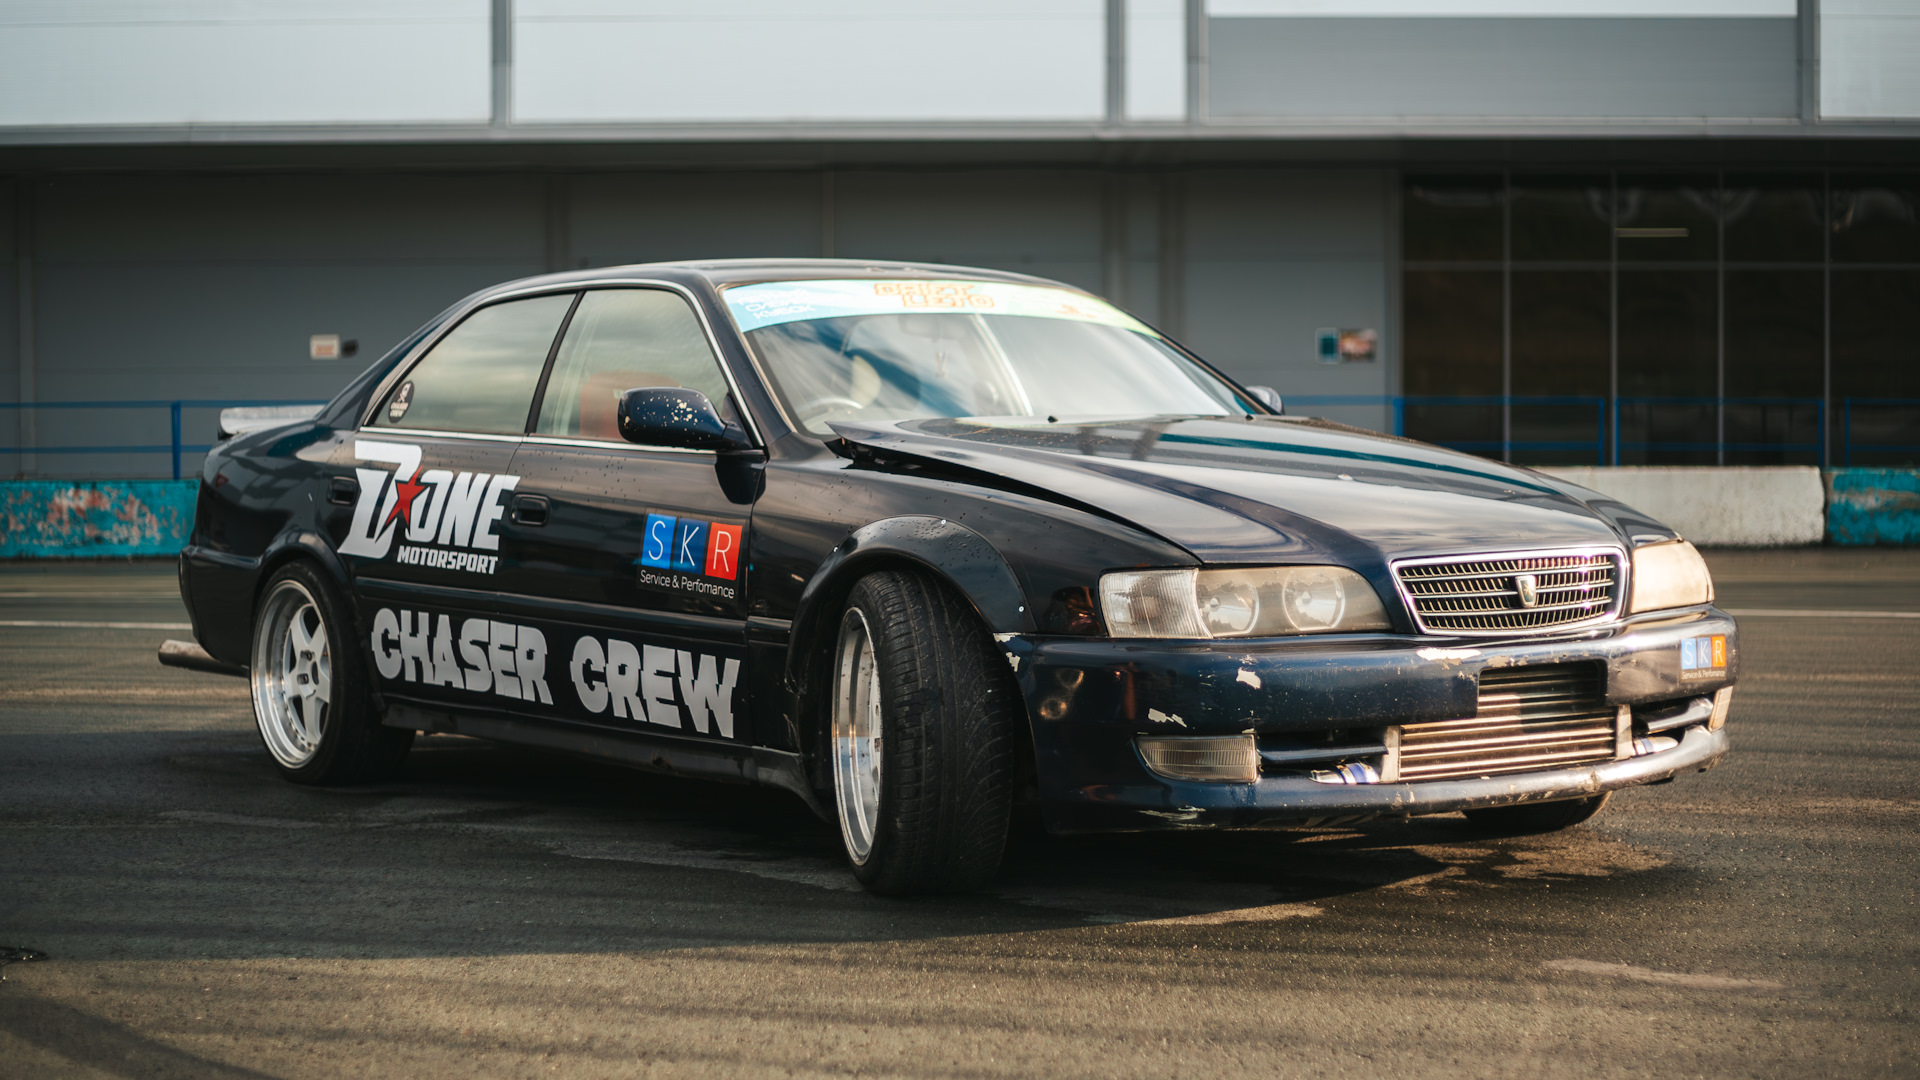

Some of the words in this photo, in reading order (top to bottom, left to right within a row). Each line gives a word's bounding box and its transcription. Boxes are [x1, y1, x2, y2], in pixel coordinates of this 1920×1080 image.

[397, 545, 499, 575] MOTORSPORT
[647, 520, 732, 573] SKR
[640, 569, 671, 587] Service
[671, 575, 680, 589] &
[681, 576, 735, 599] Perfomance
[1684, 640, 1723, 666] SKR
[371, 607, 554, 705] CHASER
[570, 635, 741, 739] CREW
